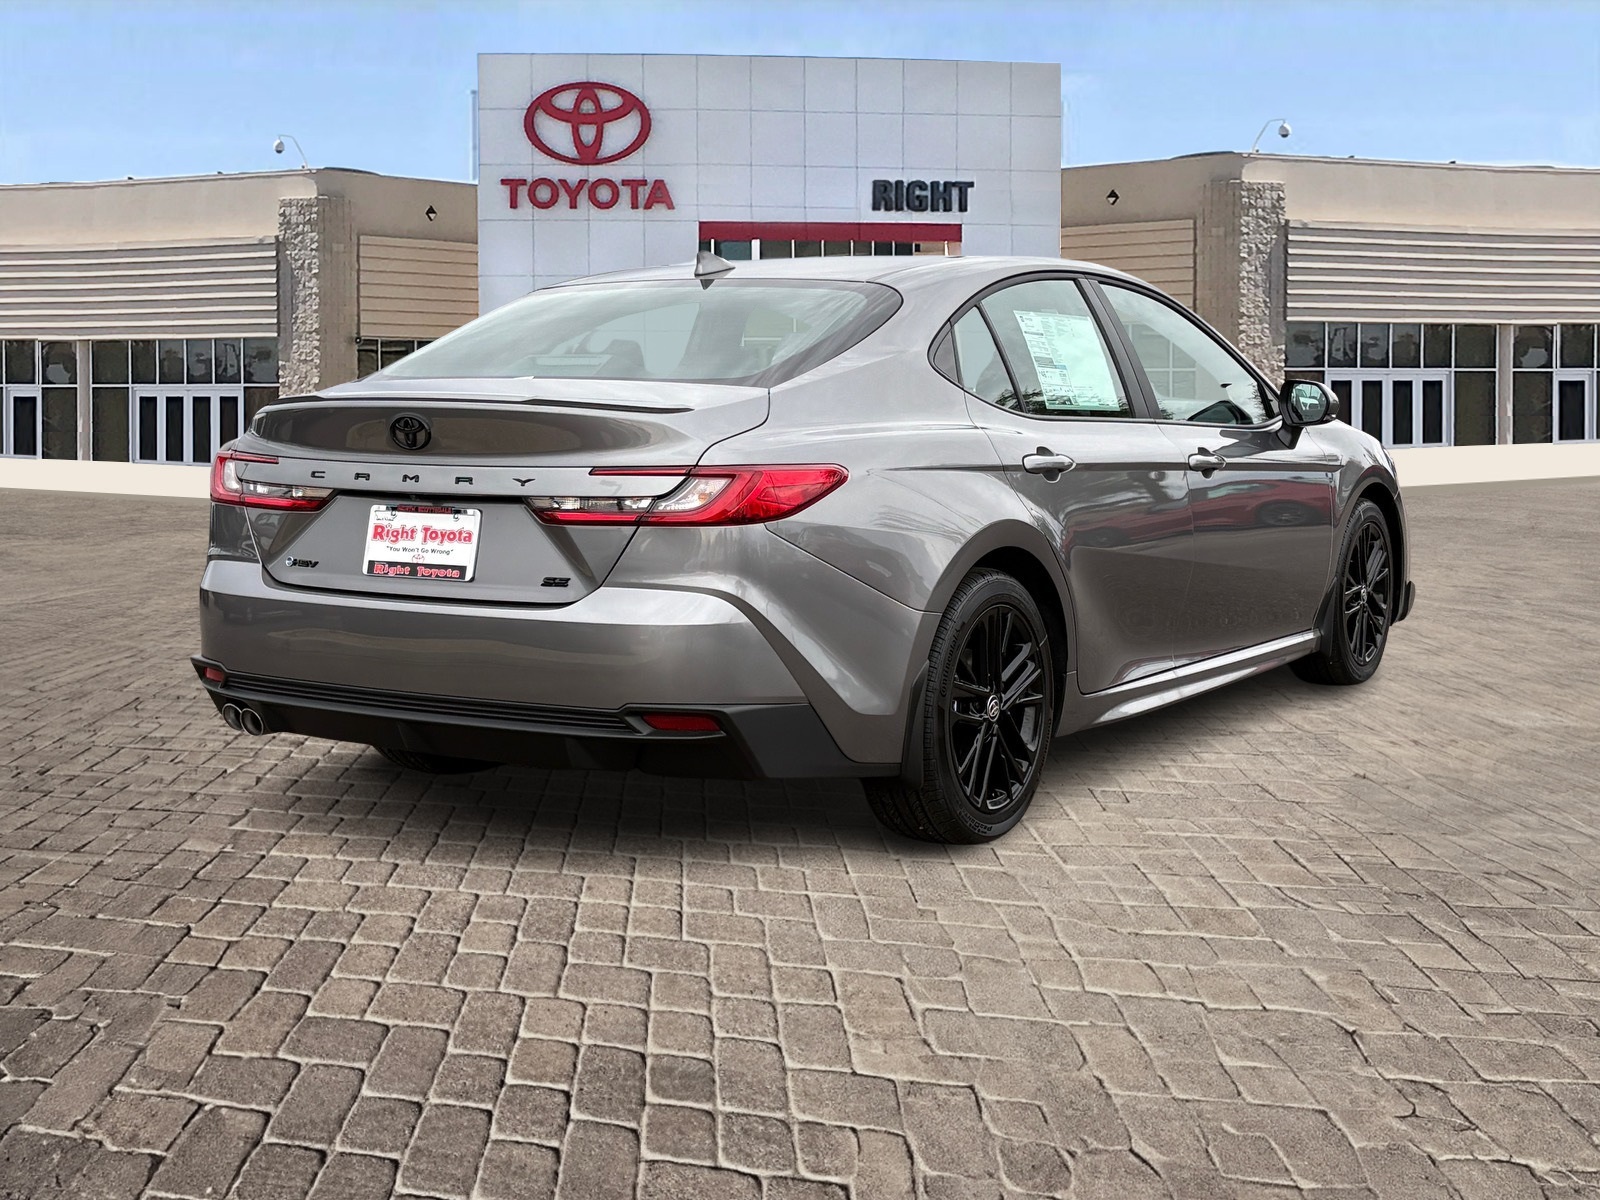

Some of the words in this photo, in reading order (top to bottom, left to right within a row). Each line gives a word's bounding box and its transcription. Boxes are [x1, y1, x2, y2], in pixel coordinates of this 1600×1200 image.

[500, 178, 675, 210] TOYOTA
[872, 179, 975, 212] RIGHT
[310, 470, 536, 487] CAMRY
[372, 524, 417, 543] Right
[422, 526, 474, 545] Toyota
[373, 563, 411, 576] Right
[417, 566, 460, 578] Toyota
